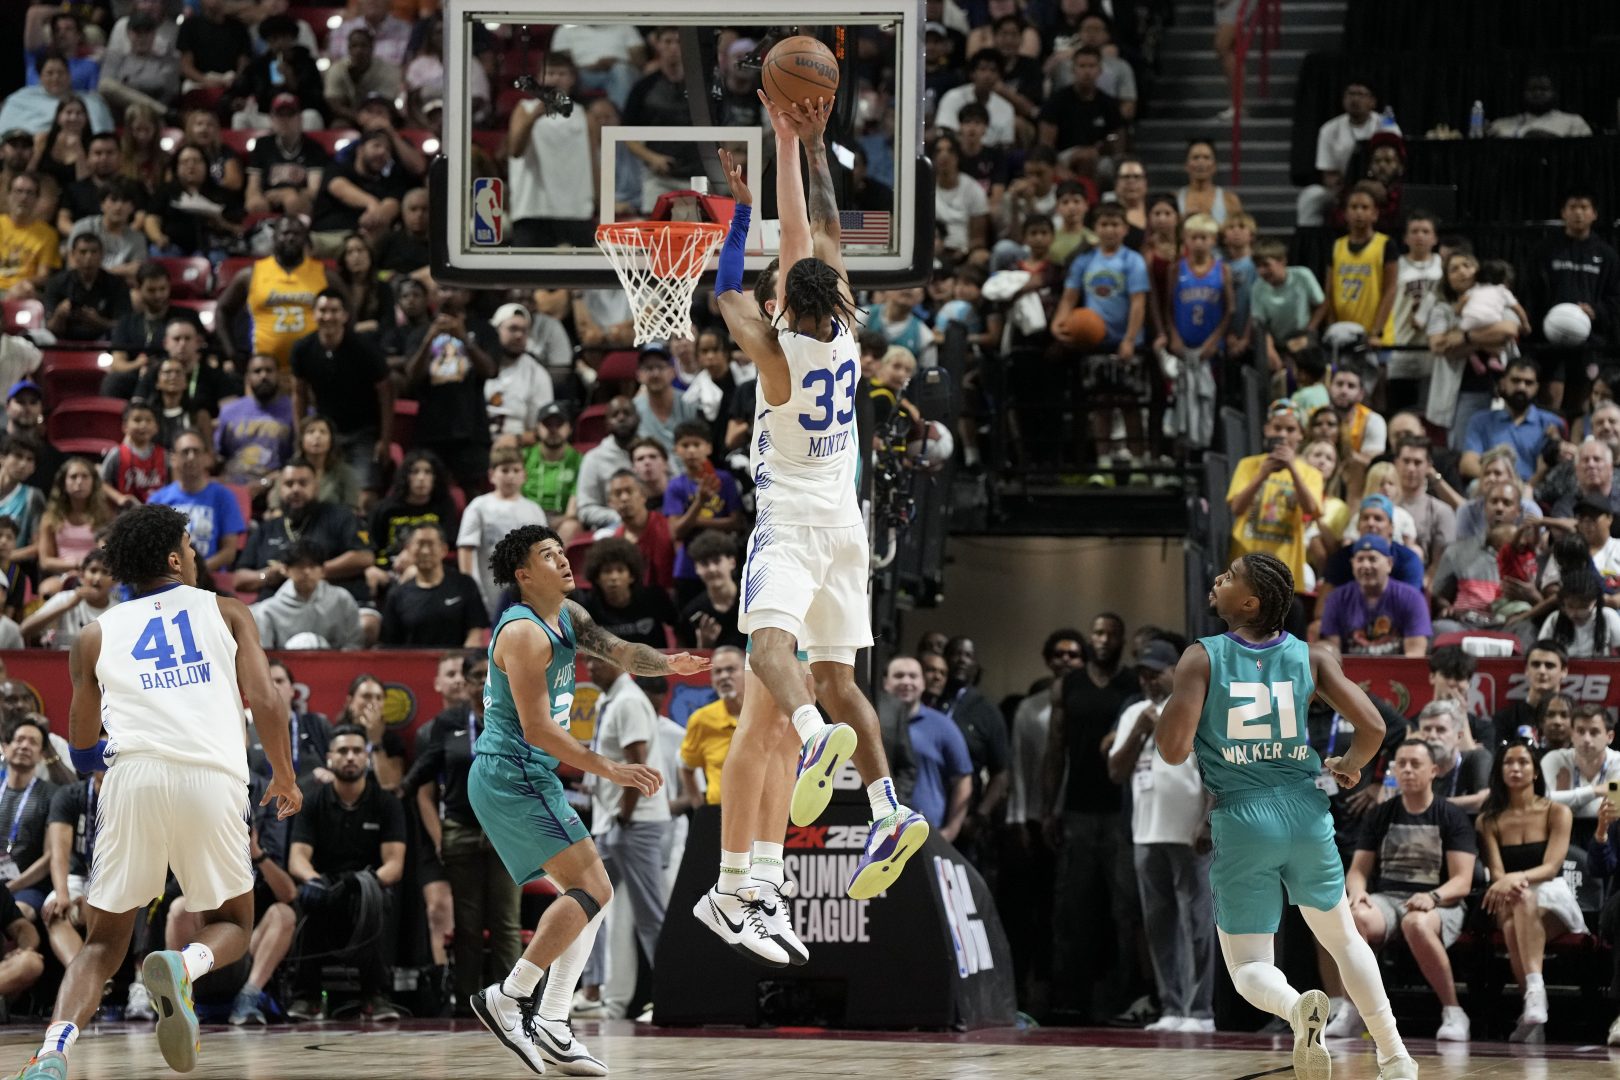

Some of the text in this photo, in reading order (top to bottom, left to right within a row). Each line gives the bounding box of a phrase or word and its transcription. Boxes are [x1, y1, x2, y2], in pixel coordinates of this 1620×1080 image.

[795, 56, 838, 84] Wilson
[272, 306, 305, 333] 23
[798, 358, 856, 431] 33
[807, 430, 849, 457] MINTZ
[131, 609, 203, 670] 41
[139, 662, 210, 690] BARLOW
[1226, 680, 1298, 740] 21
[1221, 742, 1310, 765] WALKER JR.
[784, 825, 870, 849] 2K26
[784, 854, 888, 898] SUMM
[786, 898, 871, 943] EAGUE
